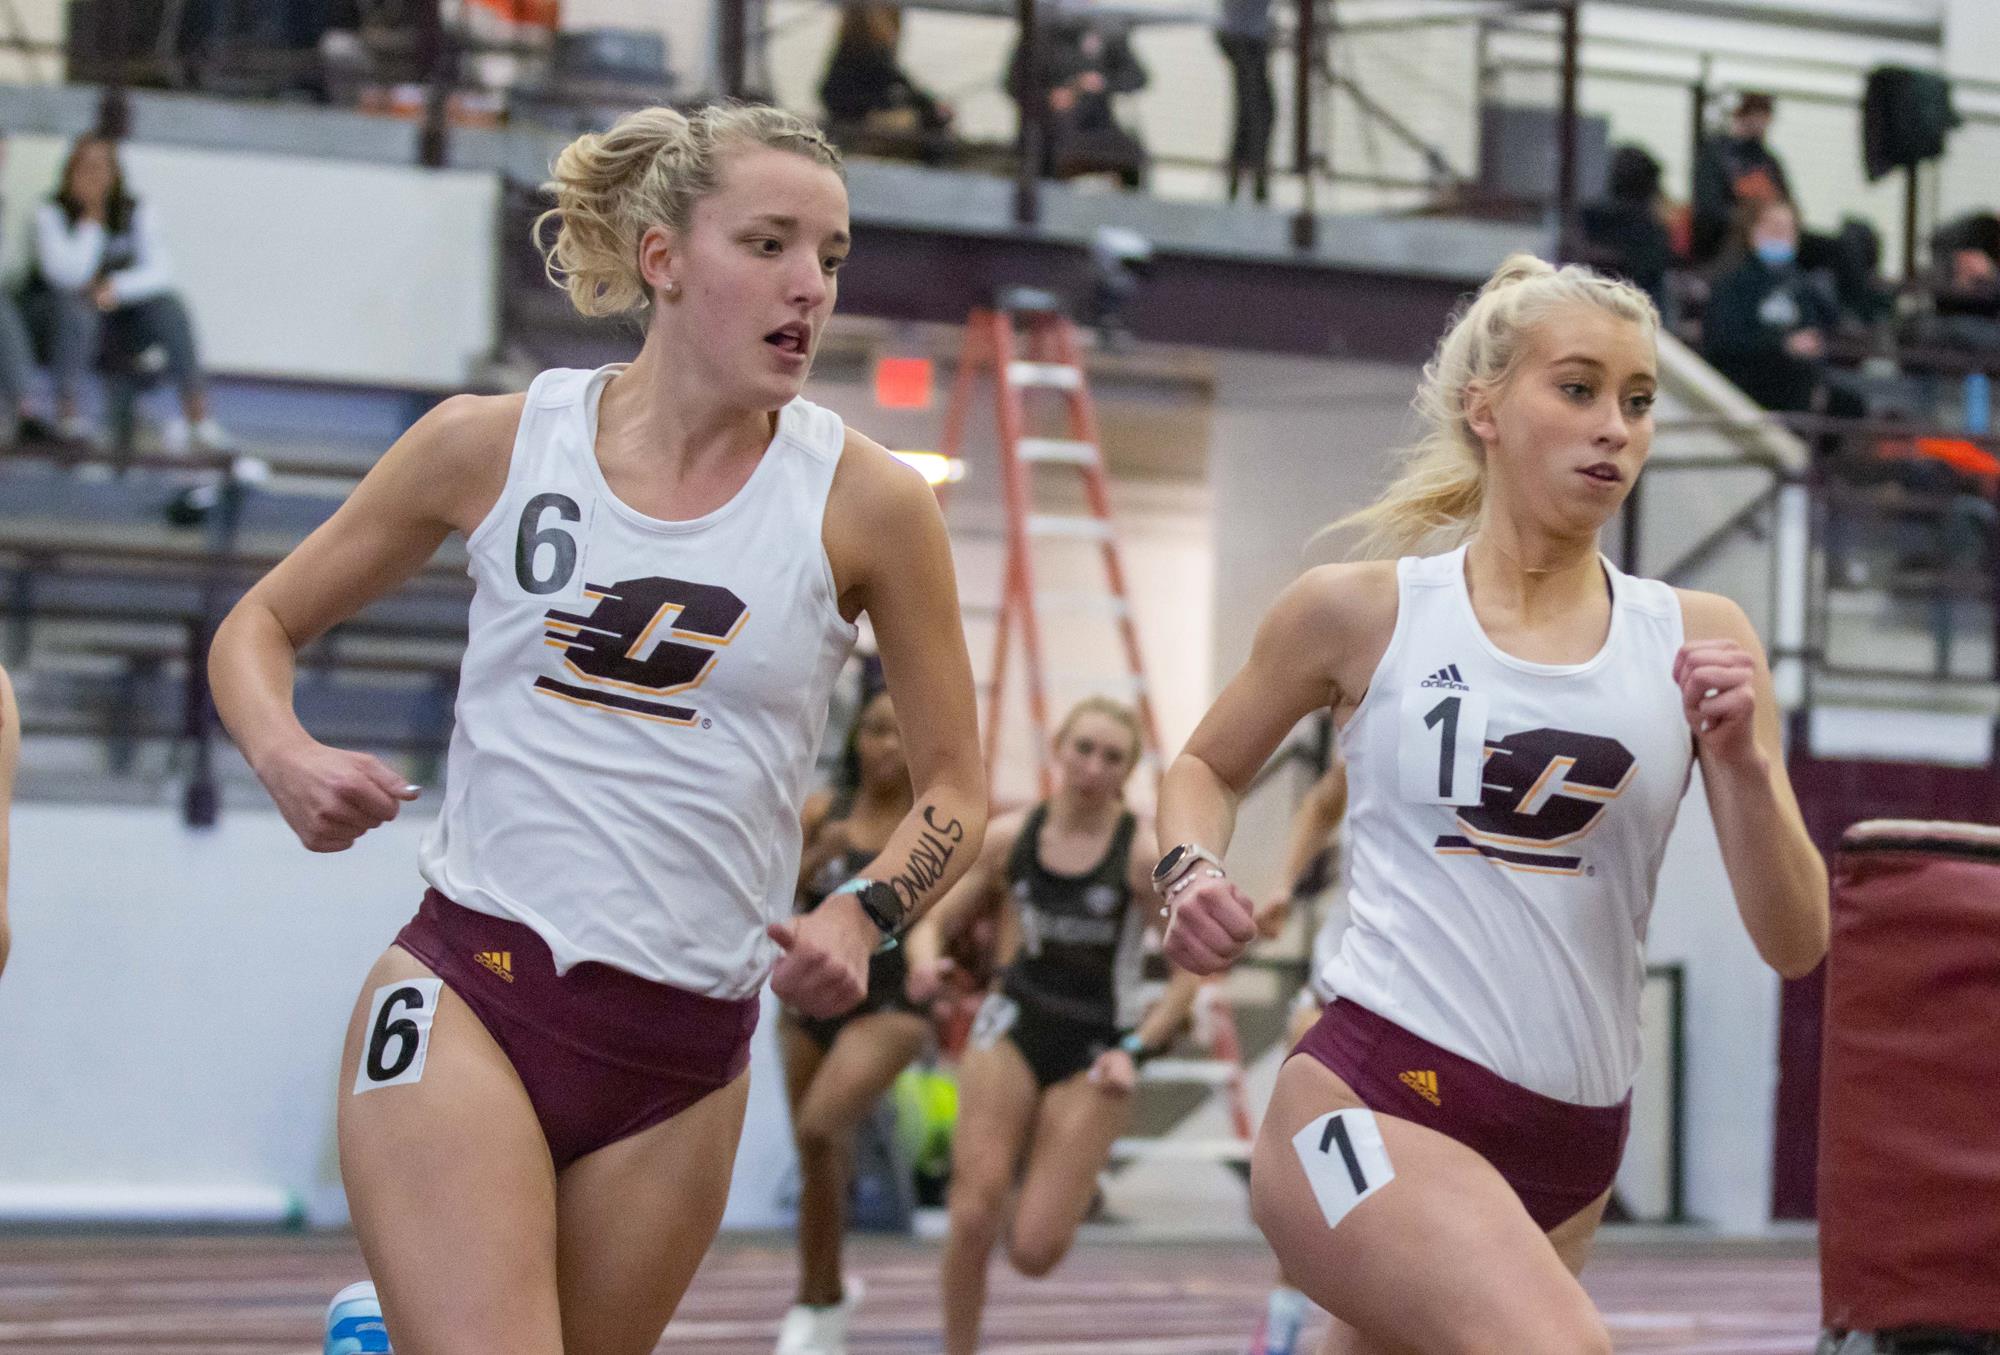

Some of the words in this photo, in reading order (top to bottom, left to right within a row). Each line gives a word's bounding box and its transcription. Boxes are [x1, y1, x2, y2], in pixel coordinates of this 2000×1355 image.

[515, 492, 581, 595] 6
[1420, 679, 1470, 691] adidas
[1423, 696, 1462, 798] 1
[473, 953, 514, 983] adidas
[367, 986, 424, 1082] 6
[1319, 1114, 1369, 1196] 1
